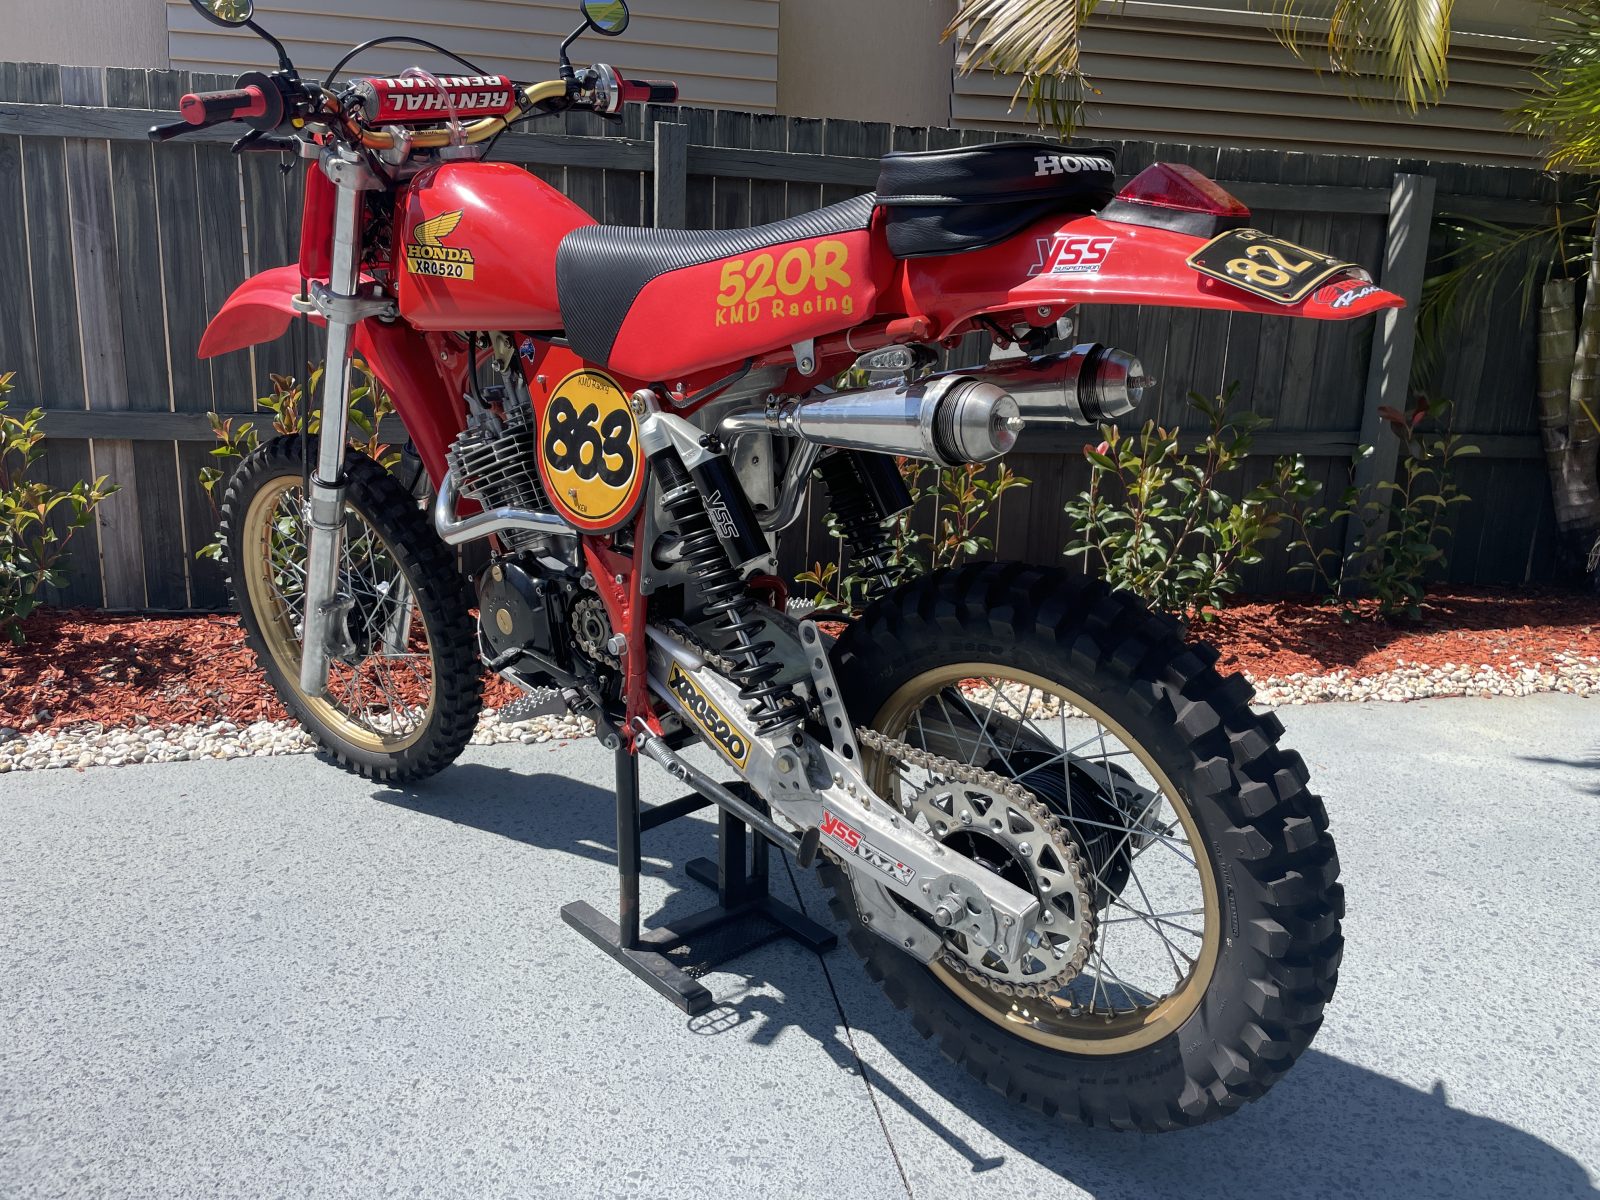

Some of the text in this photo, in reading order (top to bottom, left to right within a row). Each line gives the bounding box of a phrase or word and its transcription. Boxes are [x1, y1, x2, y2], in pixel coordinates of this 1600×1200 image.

[387, 91, 508, 111] RENTHAL
[407, 245, 474, 262] HONDA
[716, 240, 851, 306] 520R
[1027, 236, 1117, 276] YSS
[1224, 238, 1324, 287] 82
[715, 295, 853, 327] KMD Racing
[545, 396, 636, 488] 863
[701, 489, 740, 539] YSS
[820, 809, 862, 848] YSS
